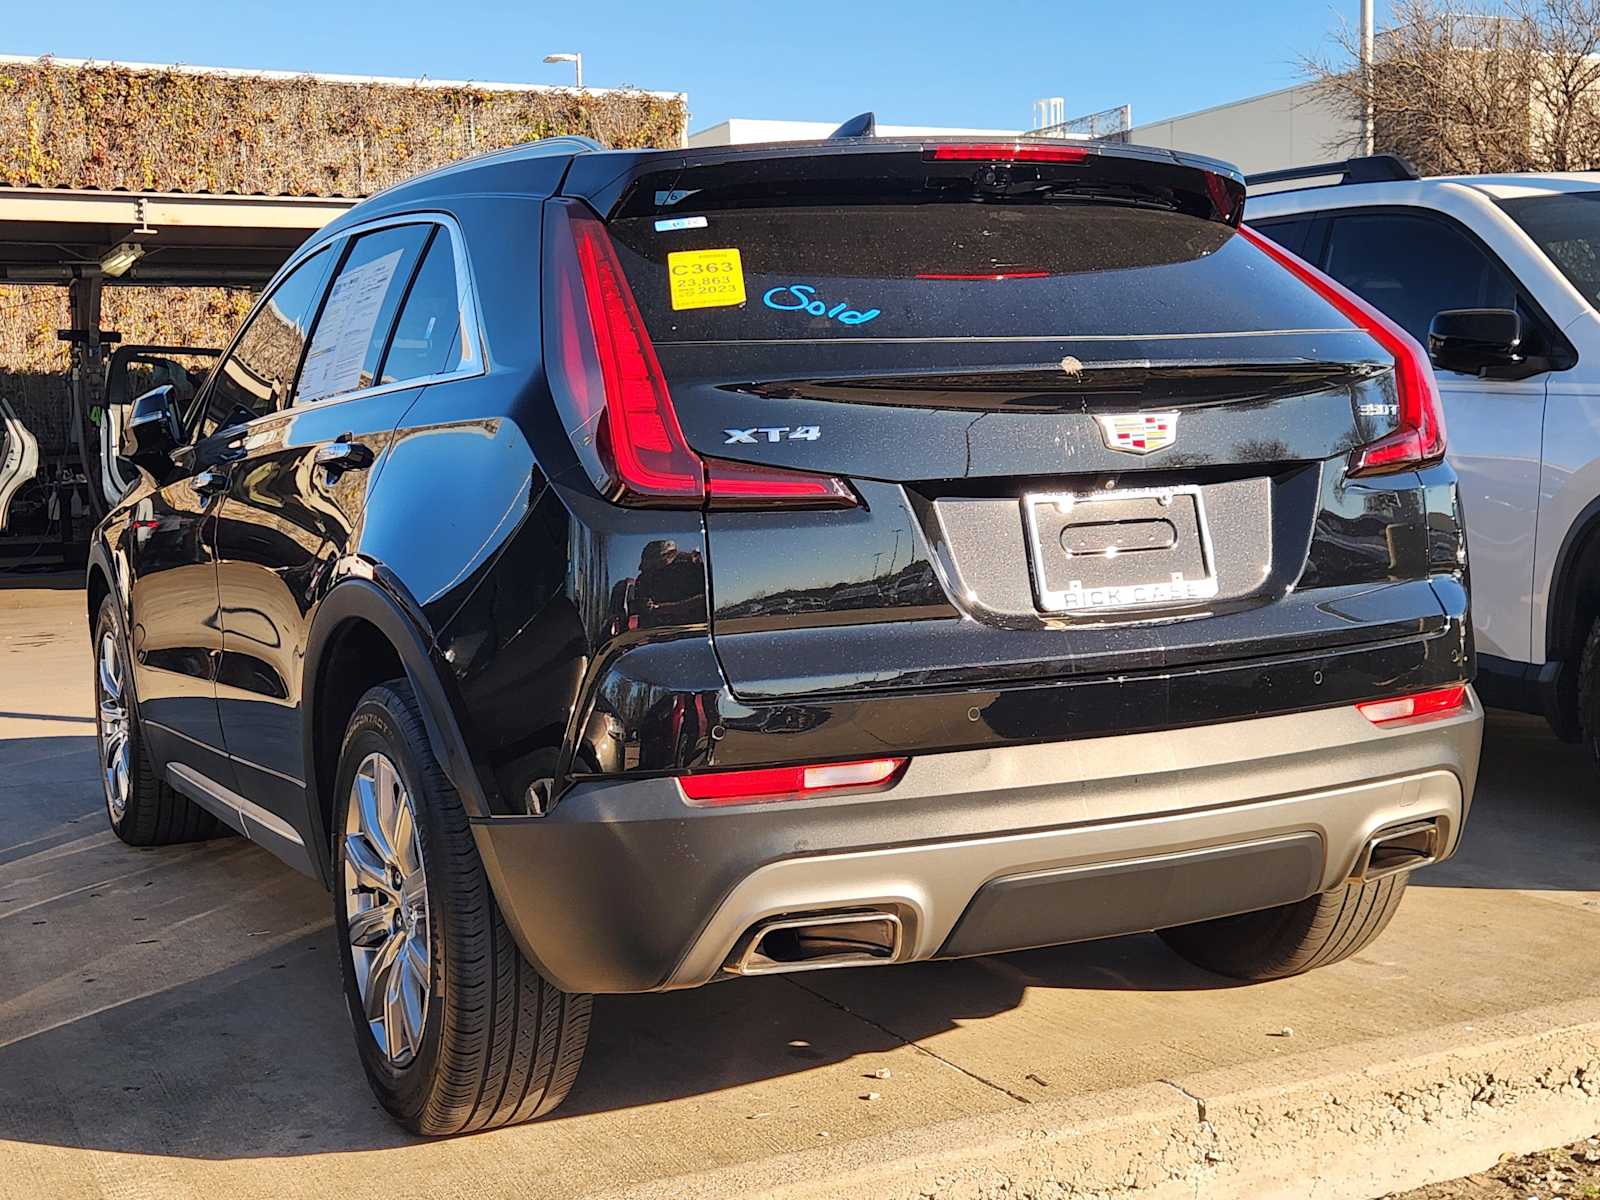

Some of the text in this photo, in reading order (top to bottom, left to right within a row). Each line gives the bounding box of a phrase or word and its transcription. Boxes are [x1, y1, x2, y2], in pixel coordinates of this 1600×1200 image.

[672, 262, 734, 276] C363
[697, 284, 737, 295] 2023
[763, 285, 880, 325] Sold
[723, 425, 821, 444] XT4
